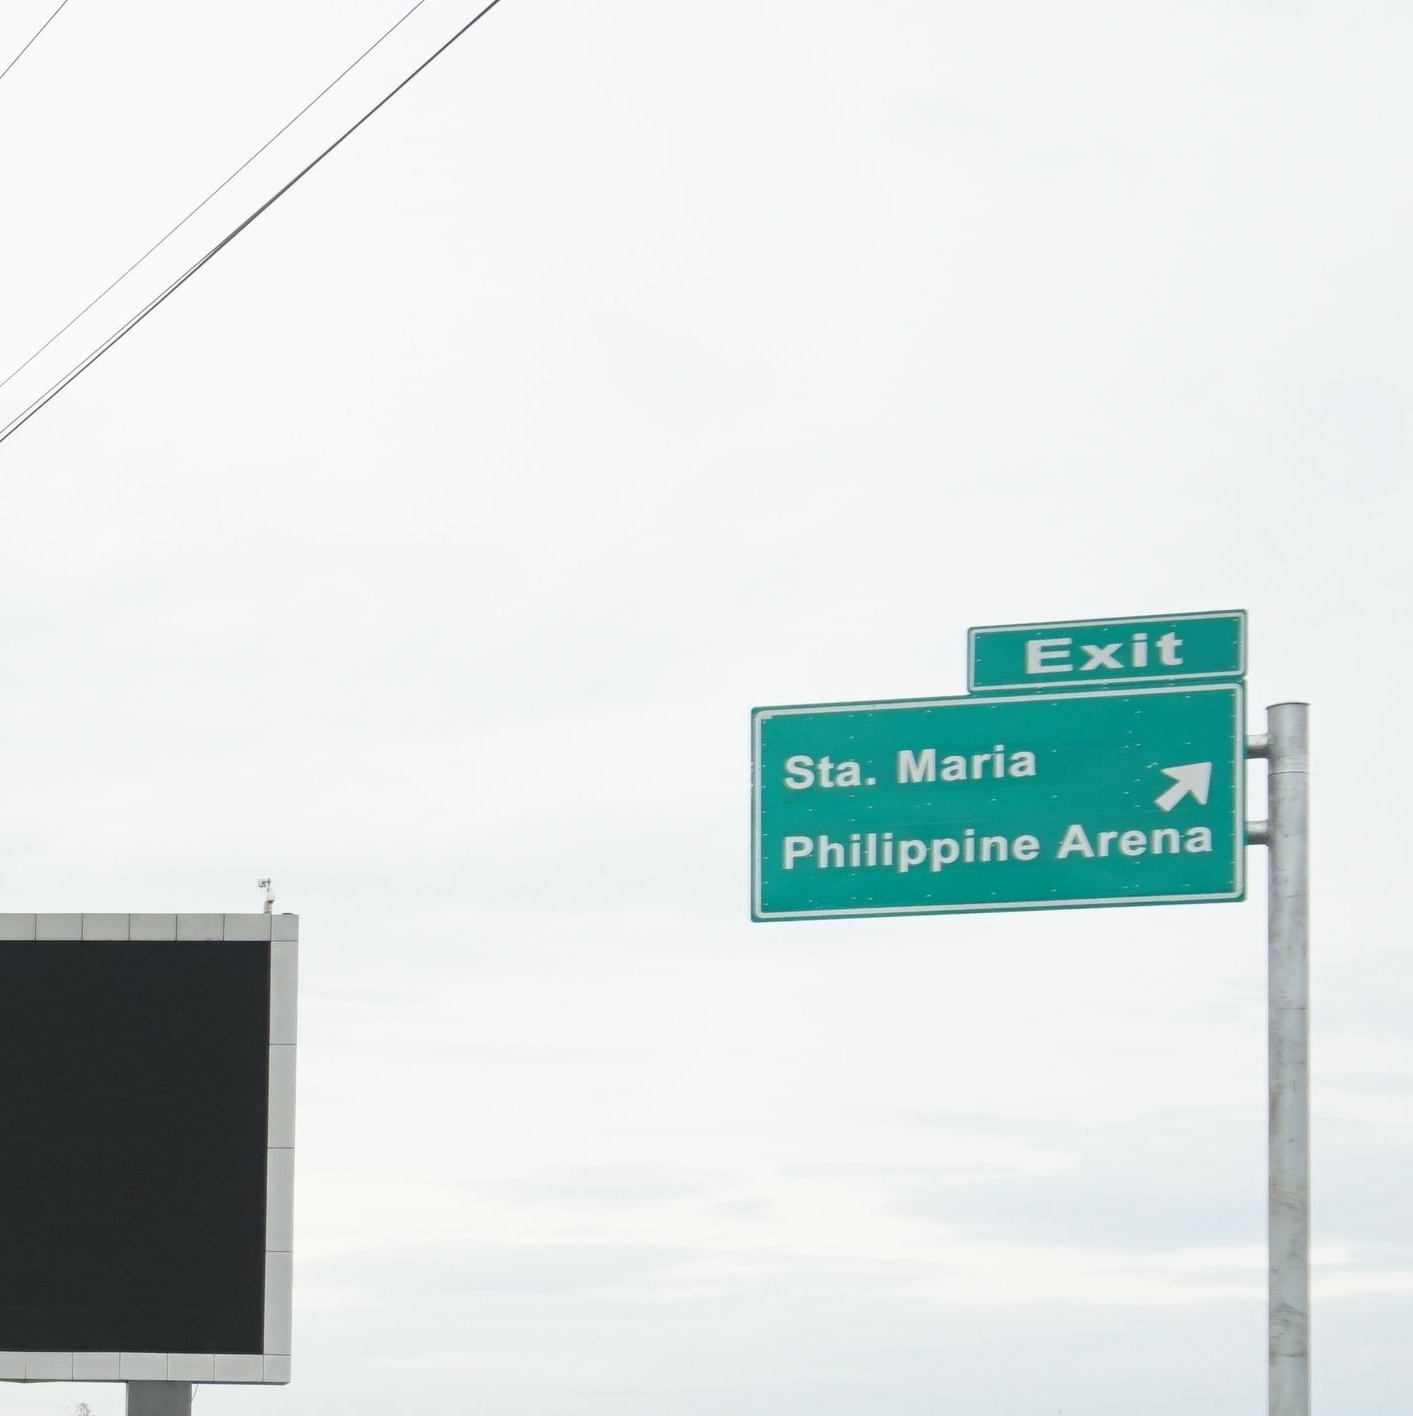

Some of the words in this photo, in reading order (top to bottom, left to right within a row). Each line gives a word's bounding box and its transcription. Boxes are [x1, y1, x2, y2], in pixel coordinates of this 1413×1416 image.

[1024, 631, 1184, 675] Exit
[782, 753, 876, 790] Sta.
[897, 743, 1037, 784] Maria
[782, 828, 1041, 873] Philippine
[1056, 824, 1212, 861] Arena
